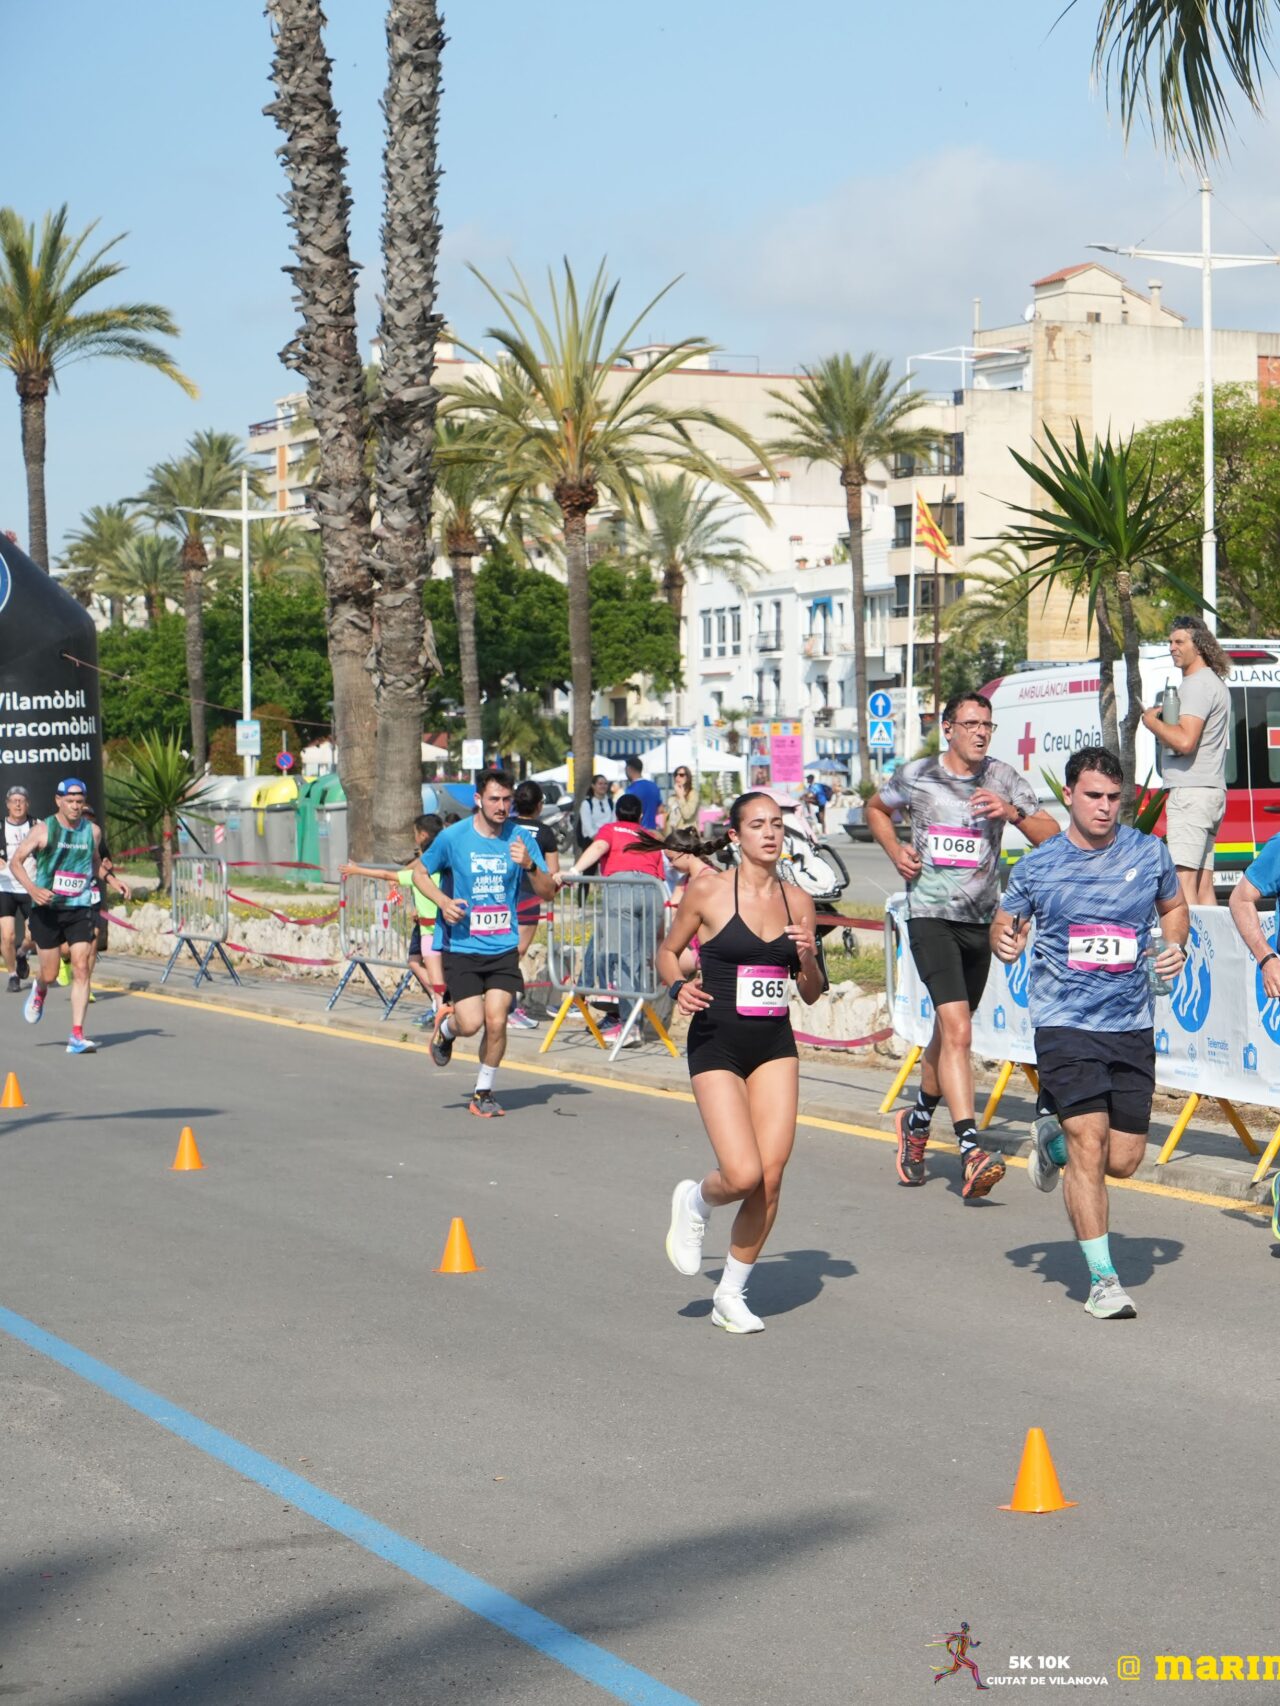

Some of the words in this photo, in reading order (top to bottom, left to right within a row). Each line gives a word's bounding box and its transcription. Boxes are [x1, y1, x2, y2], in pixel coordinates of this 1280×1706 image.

[0, 716, 97, 738] rracomòbil
[1043, 732, 1071, 753] Creu
[933, 836, 975, 853] 1068
[58, 877, 85, 889] 1087
[476, 913, 508, 925] 1017
[1082, 938, 1120, 956] 731
[751, 980, 784, 998] 865
